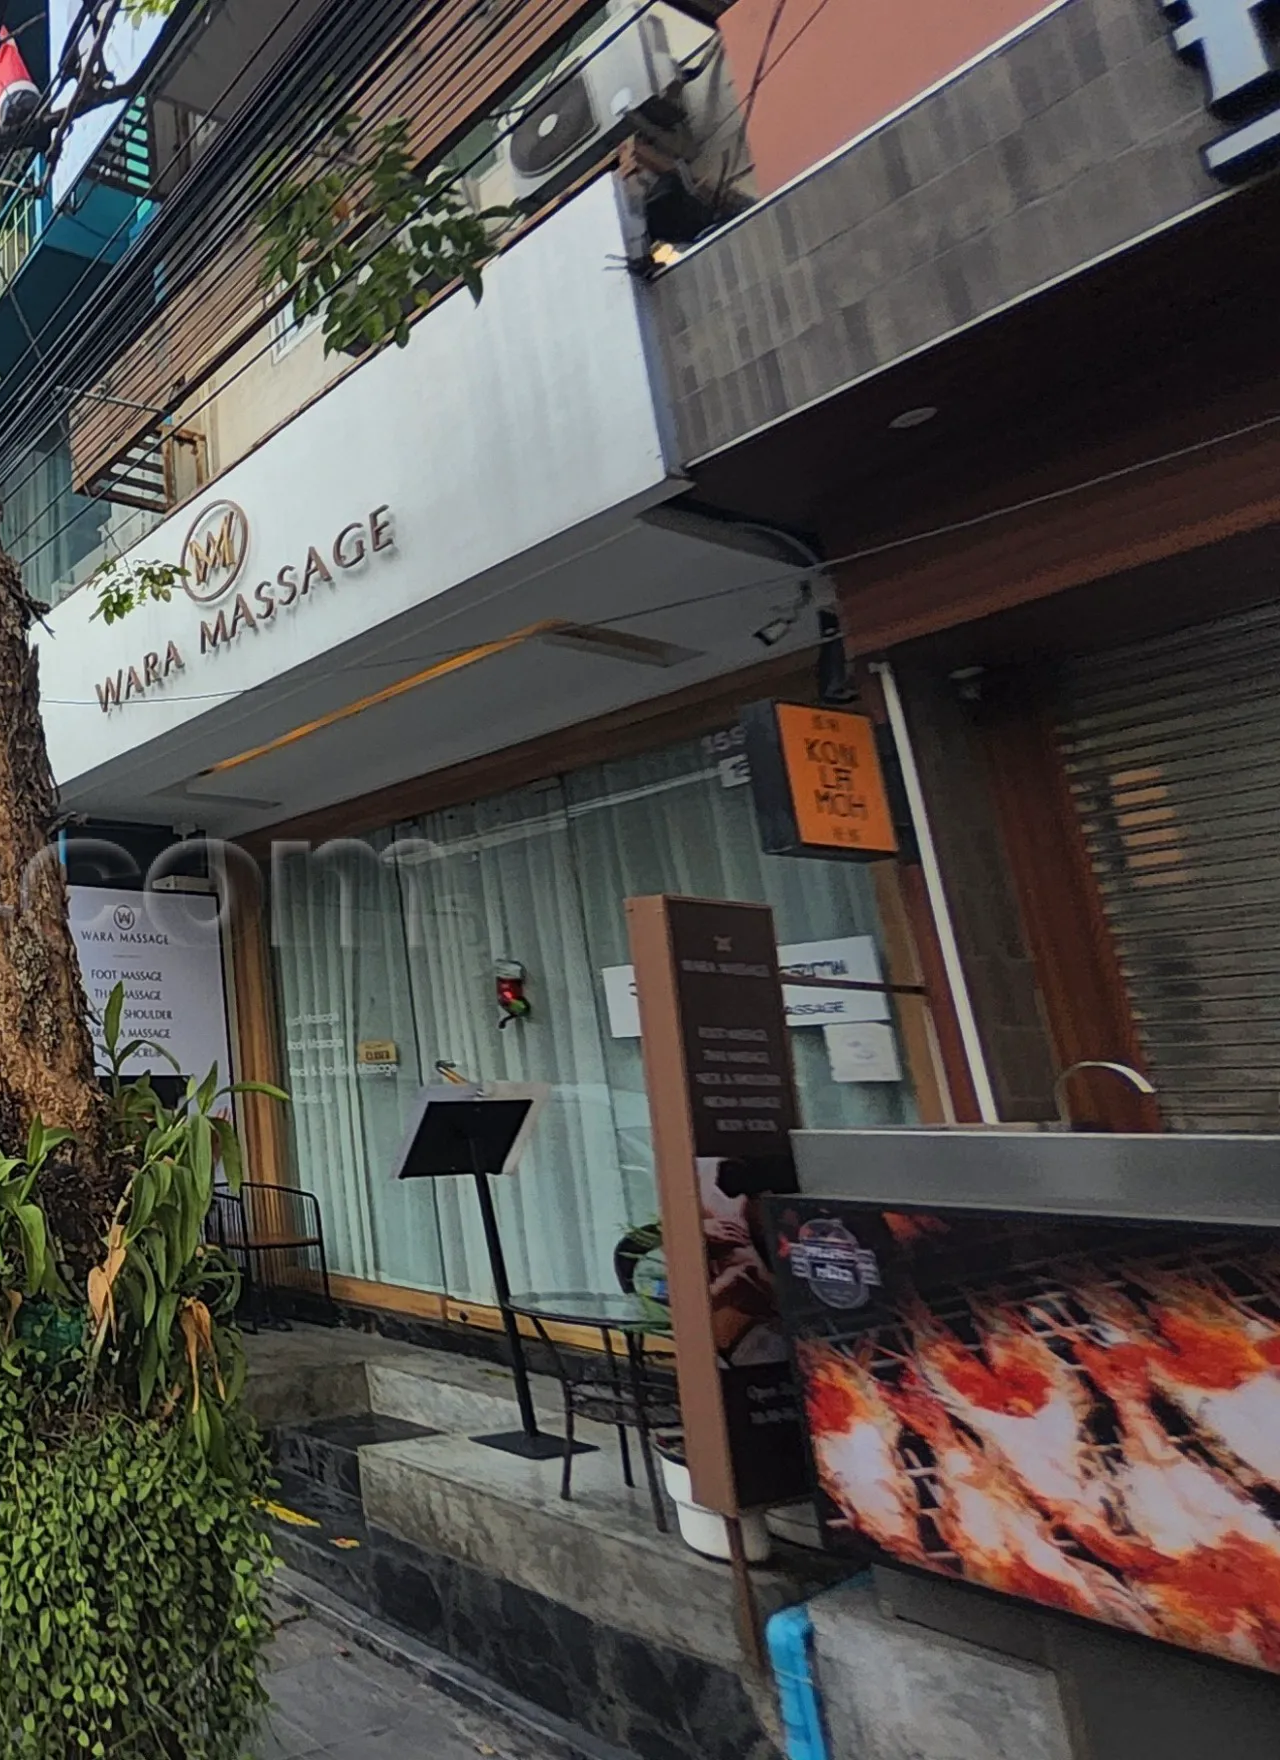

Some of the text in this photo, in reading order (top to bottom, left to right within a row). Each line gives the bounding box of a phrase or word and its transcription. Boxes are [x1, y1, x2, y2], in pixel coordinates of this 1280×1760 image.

[95, 503, 396, 713] WARA MASSAGE
[81, 930, 170, 945] WARA MASSAGE
[91, 968, 163, 982] FOOT MASSAGE
[124, 1008, 173, 1020] SHOULDER
[129, 1027, 171, 1039] MASSAGE
